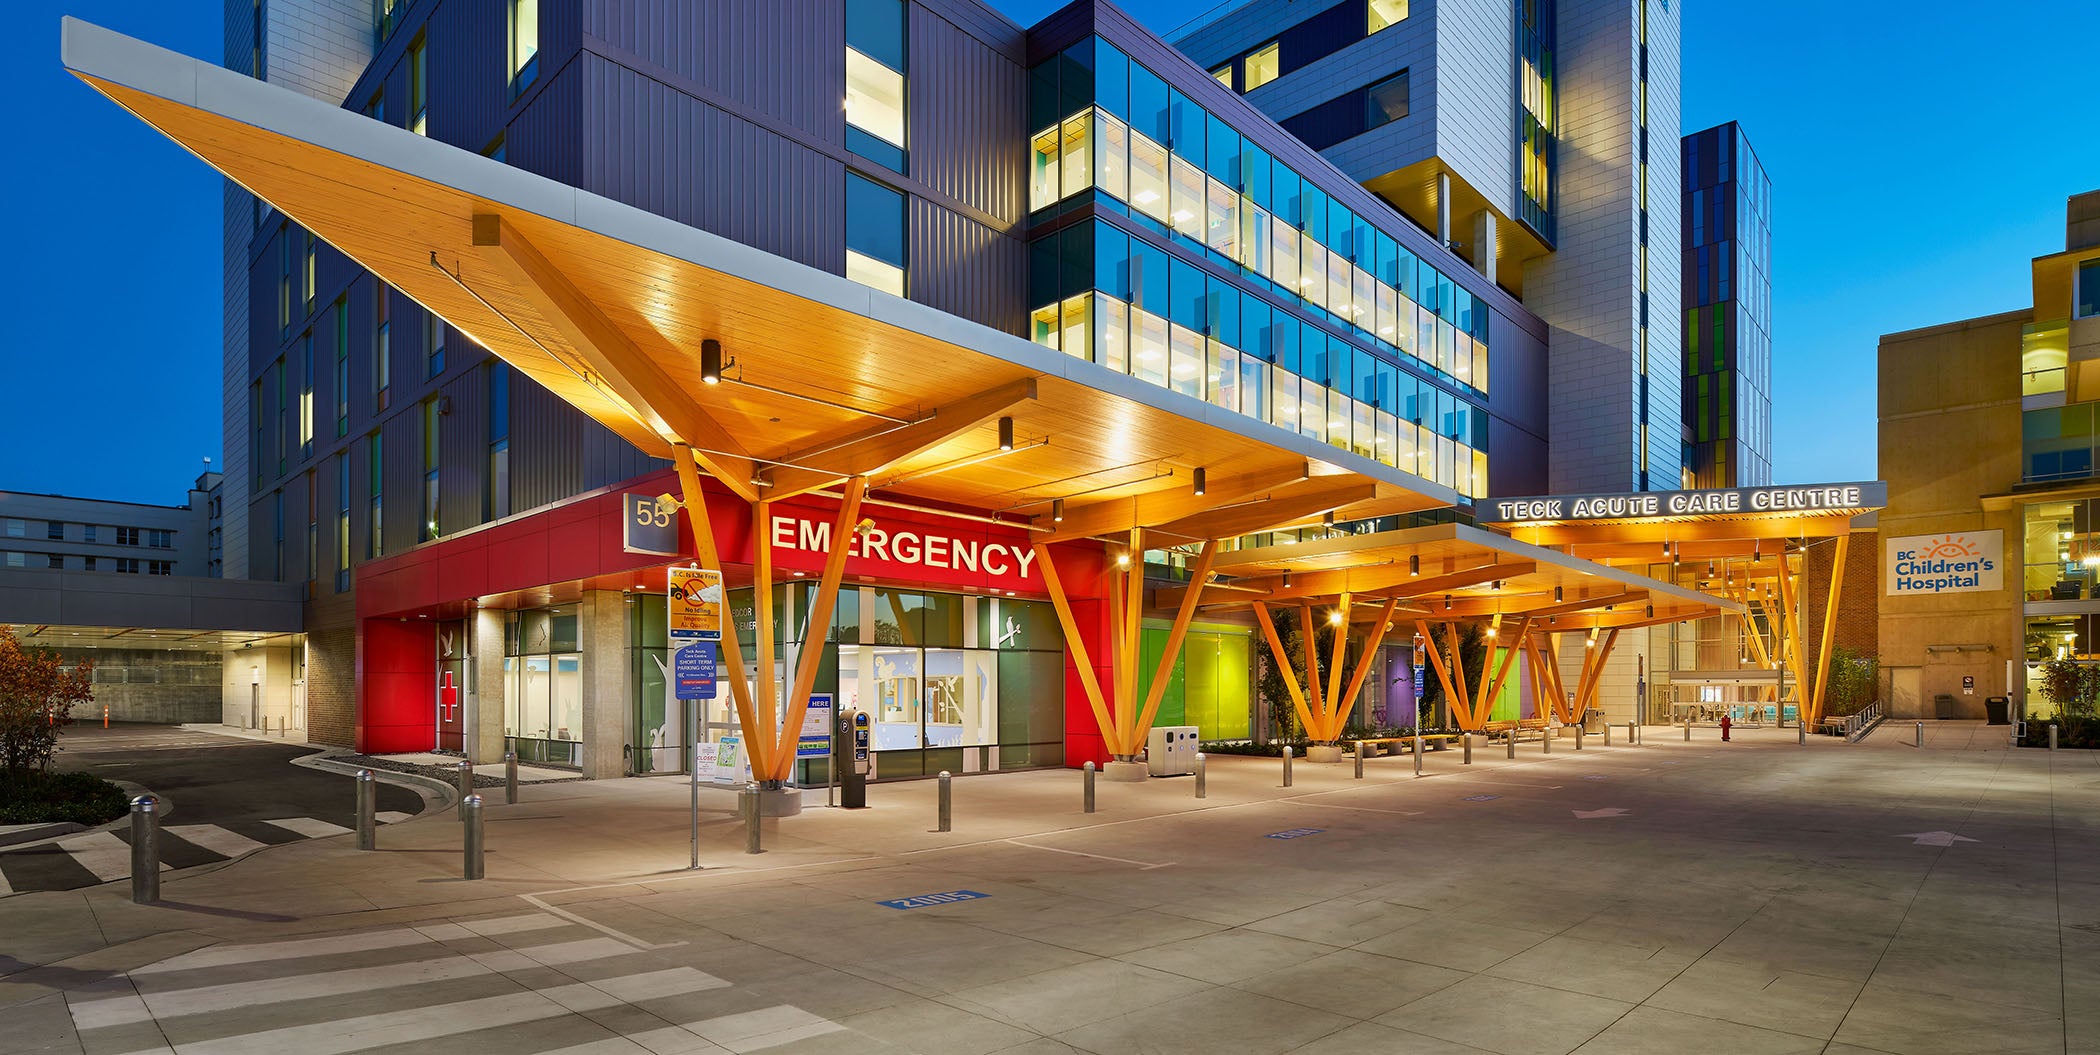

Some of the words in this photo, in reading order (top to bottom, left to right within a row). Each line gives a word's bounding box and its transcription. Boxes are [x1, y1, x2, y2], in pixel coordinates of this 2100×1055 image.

[1500, 501, 1561, 518] TECK
[1574, 497, 1658, 516] ACUTE
[1672, 494, 1740, 512] CARE
[1754, 487, 1860, 508] CENTRE
[637, 500, 670, 528] 55
[1897, 550, 1916, 560] BC
[1895, 557, 1994, 575] Children's
[1897, 572, 1979, 592] Hospital
